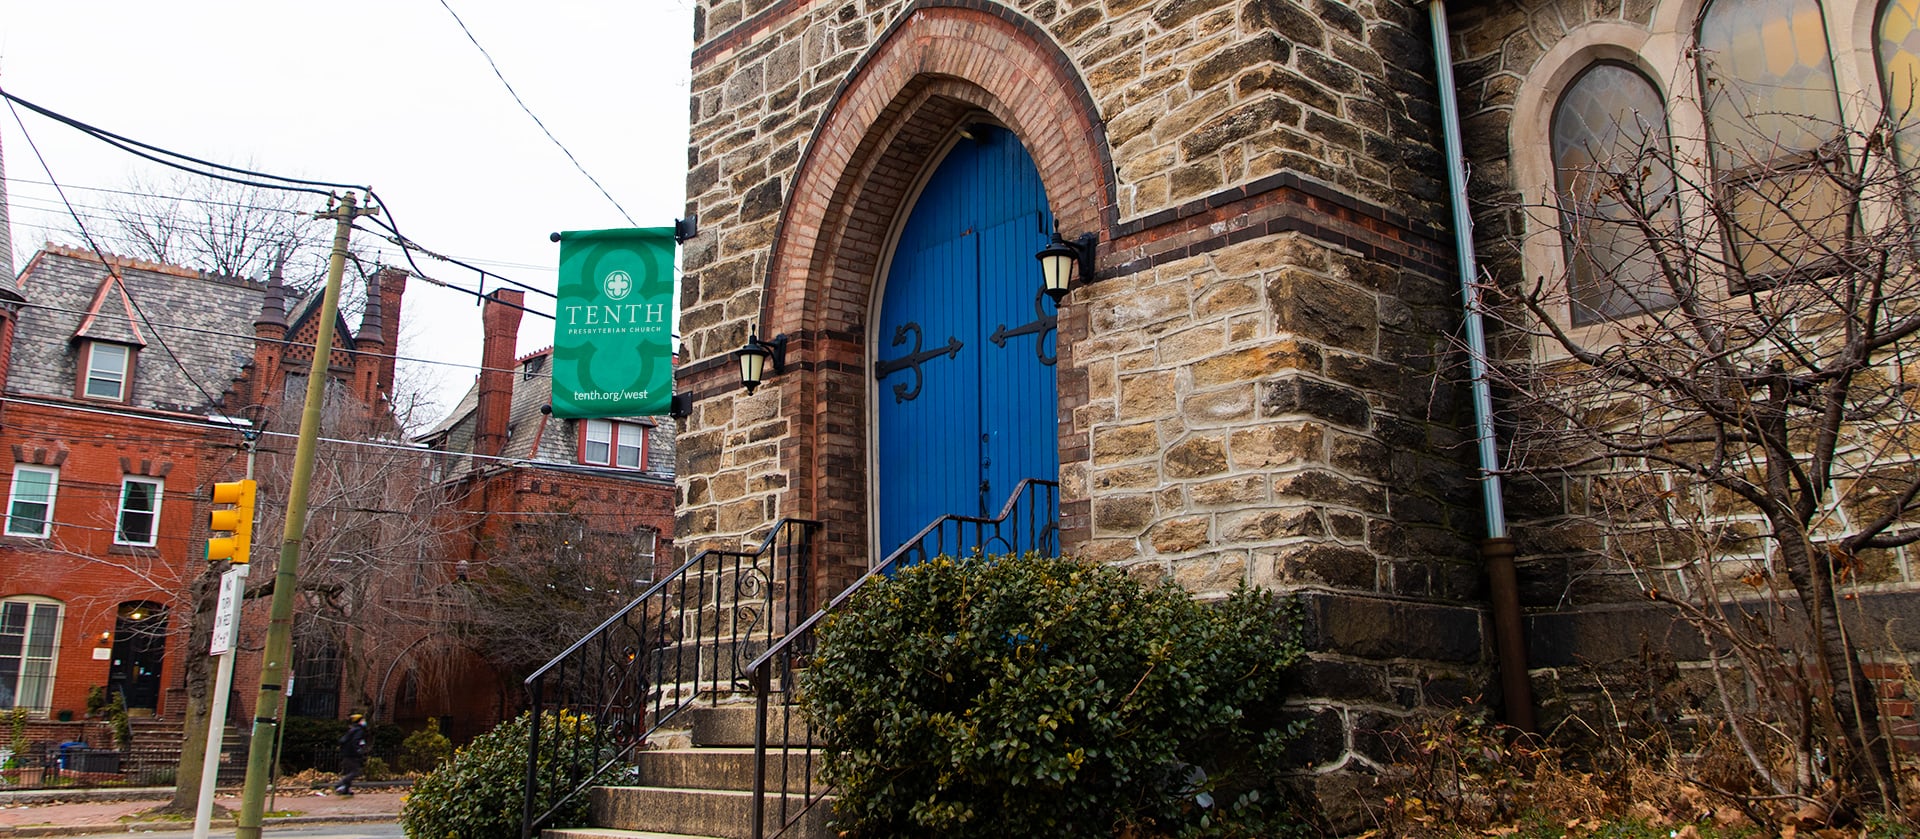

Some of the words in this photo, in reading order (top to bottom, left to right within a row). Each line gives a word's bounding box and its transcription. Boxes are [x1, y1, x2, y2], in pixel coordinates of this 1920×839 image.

[565, 303, 664, 325] TENTH
[568, 327, 626, 335] PRESBYTERIAN
[574, 389, 648, 402] tenth.org/west
